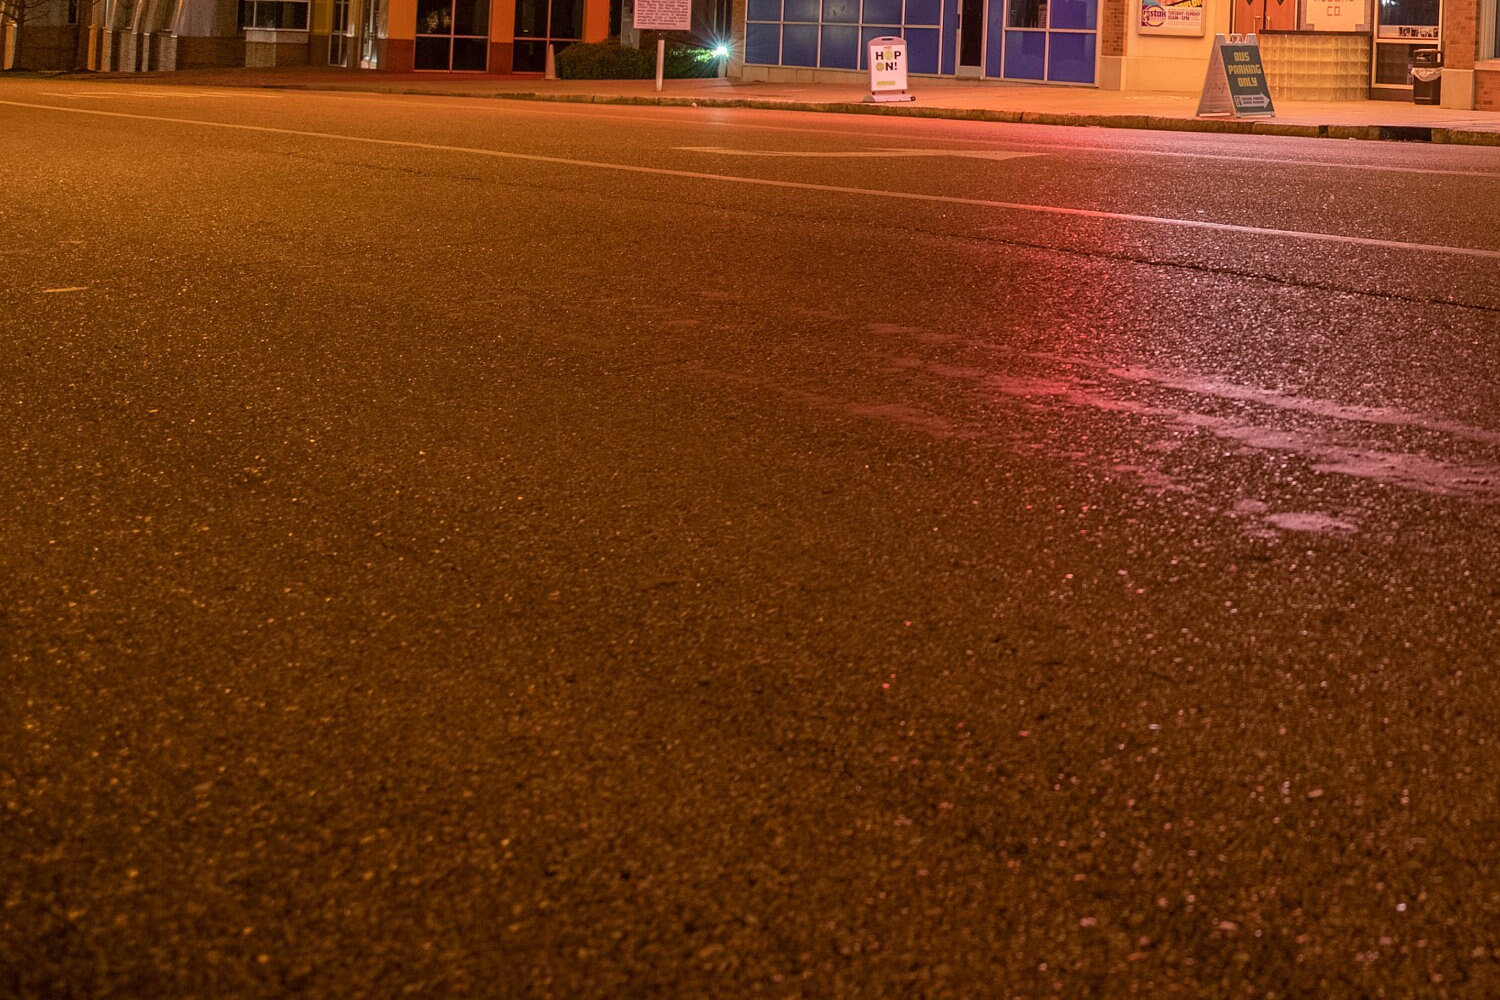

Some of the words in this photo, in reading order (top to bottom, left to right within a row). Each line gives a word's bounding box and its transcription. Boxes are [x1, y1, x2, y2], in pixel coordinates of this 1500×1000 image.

[1326, 6, 1342, 17] CO.
[875, 50, 902, 61] HOP
[1233, 51, 1250, 62] BUS
[875, 61, 897, 72] ON!
[1227, 64, 1262, 75] PARKING
[1237, 77, 1258, 87] ONLY
